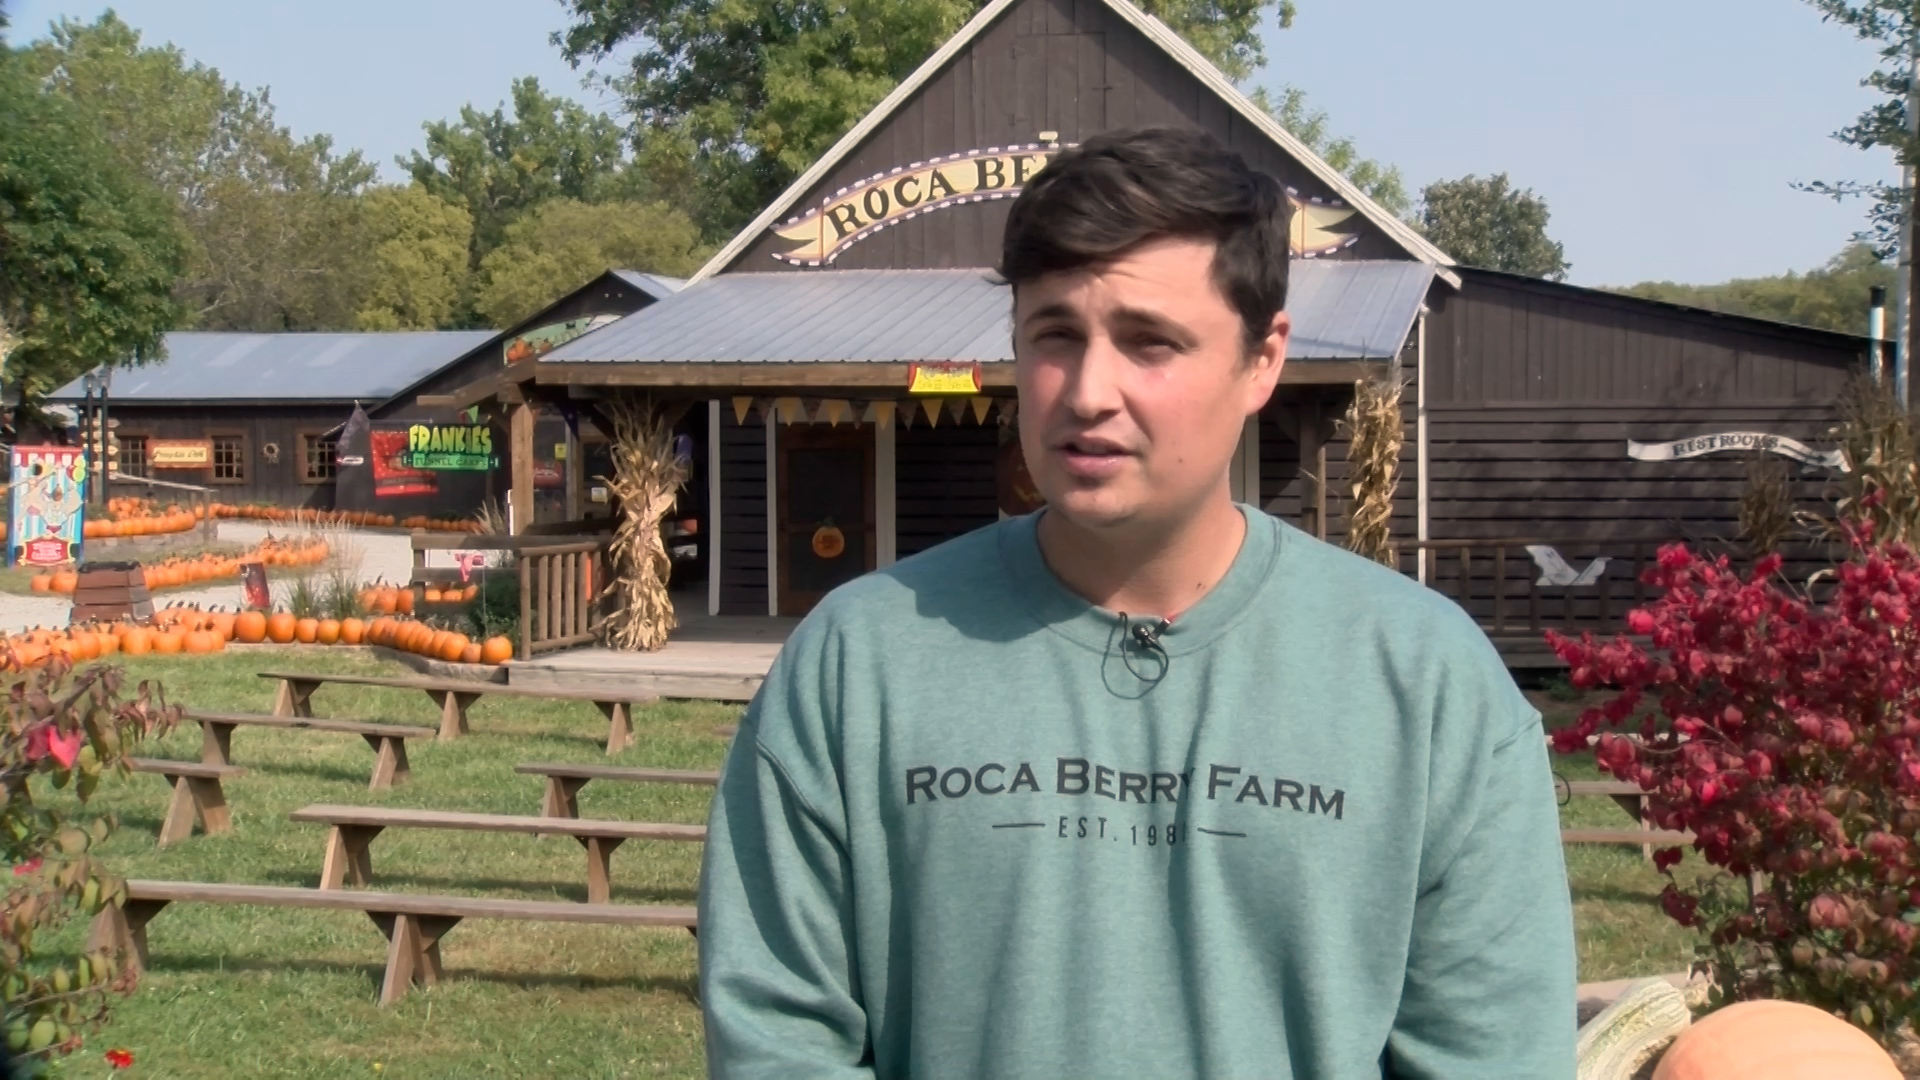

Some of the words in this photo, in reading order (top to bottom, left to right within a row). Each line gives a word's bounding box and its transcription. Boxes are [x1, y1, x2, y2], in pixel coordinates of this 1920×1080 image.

[827, 167, 960, 240] ROCA
[409, 423, 492, 455] FRANKIES
[905, 762, 1041, 804] ROCA
[1056, 757, 1197, 803] BERRY
[1207, 763, 1346, 821] FARM
[1058, 816, 1119, 842] EST.
